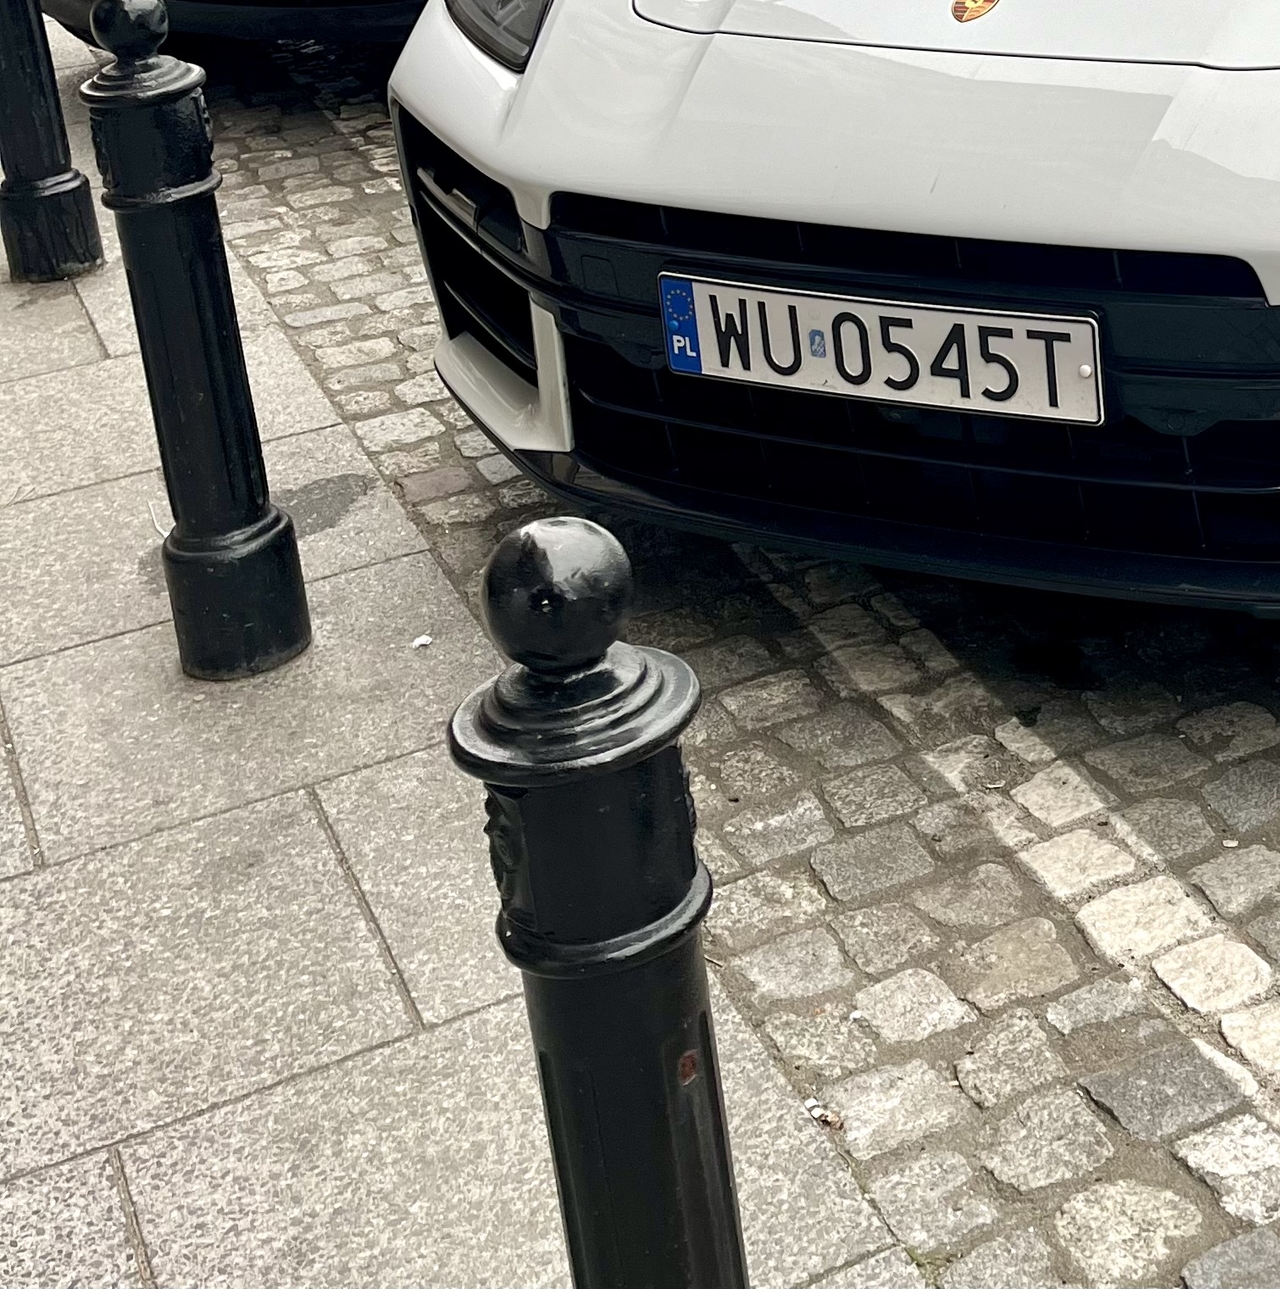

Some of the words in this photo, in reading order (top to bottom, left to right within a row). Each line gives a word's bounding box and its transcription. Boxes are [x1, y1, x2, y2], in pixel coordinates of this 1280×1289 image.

[672, 335, 697, 358] PL
[708, 294, 802, 376] WU
[831, 311, 1072, 408] 0545T
